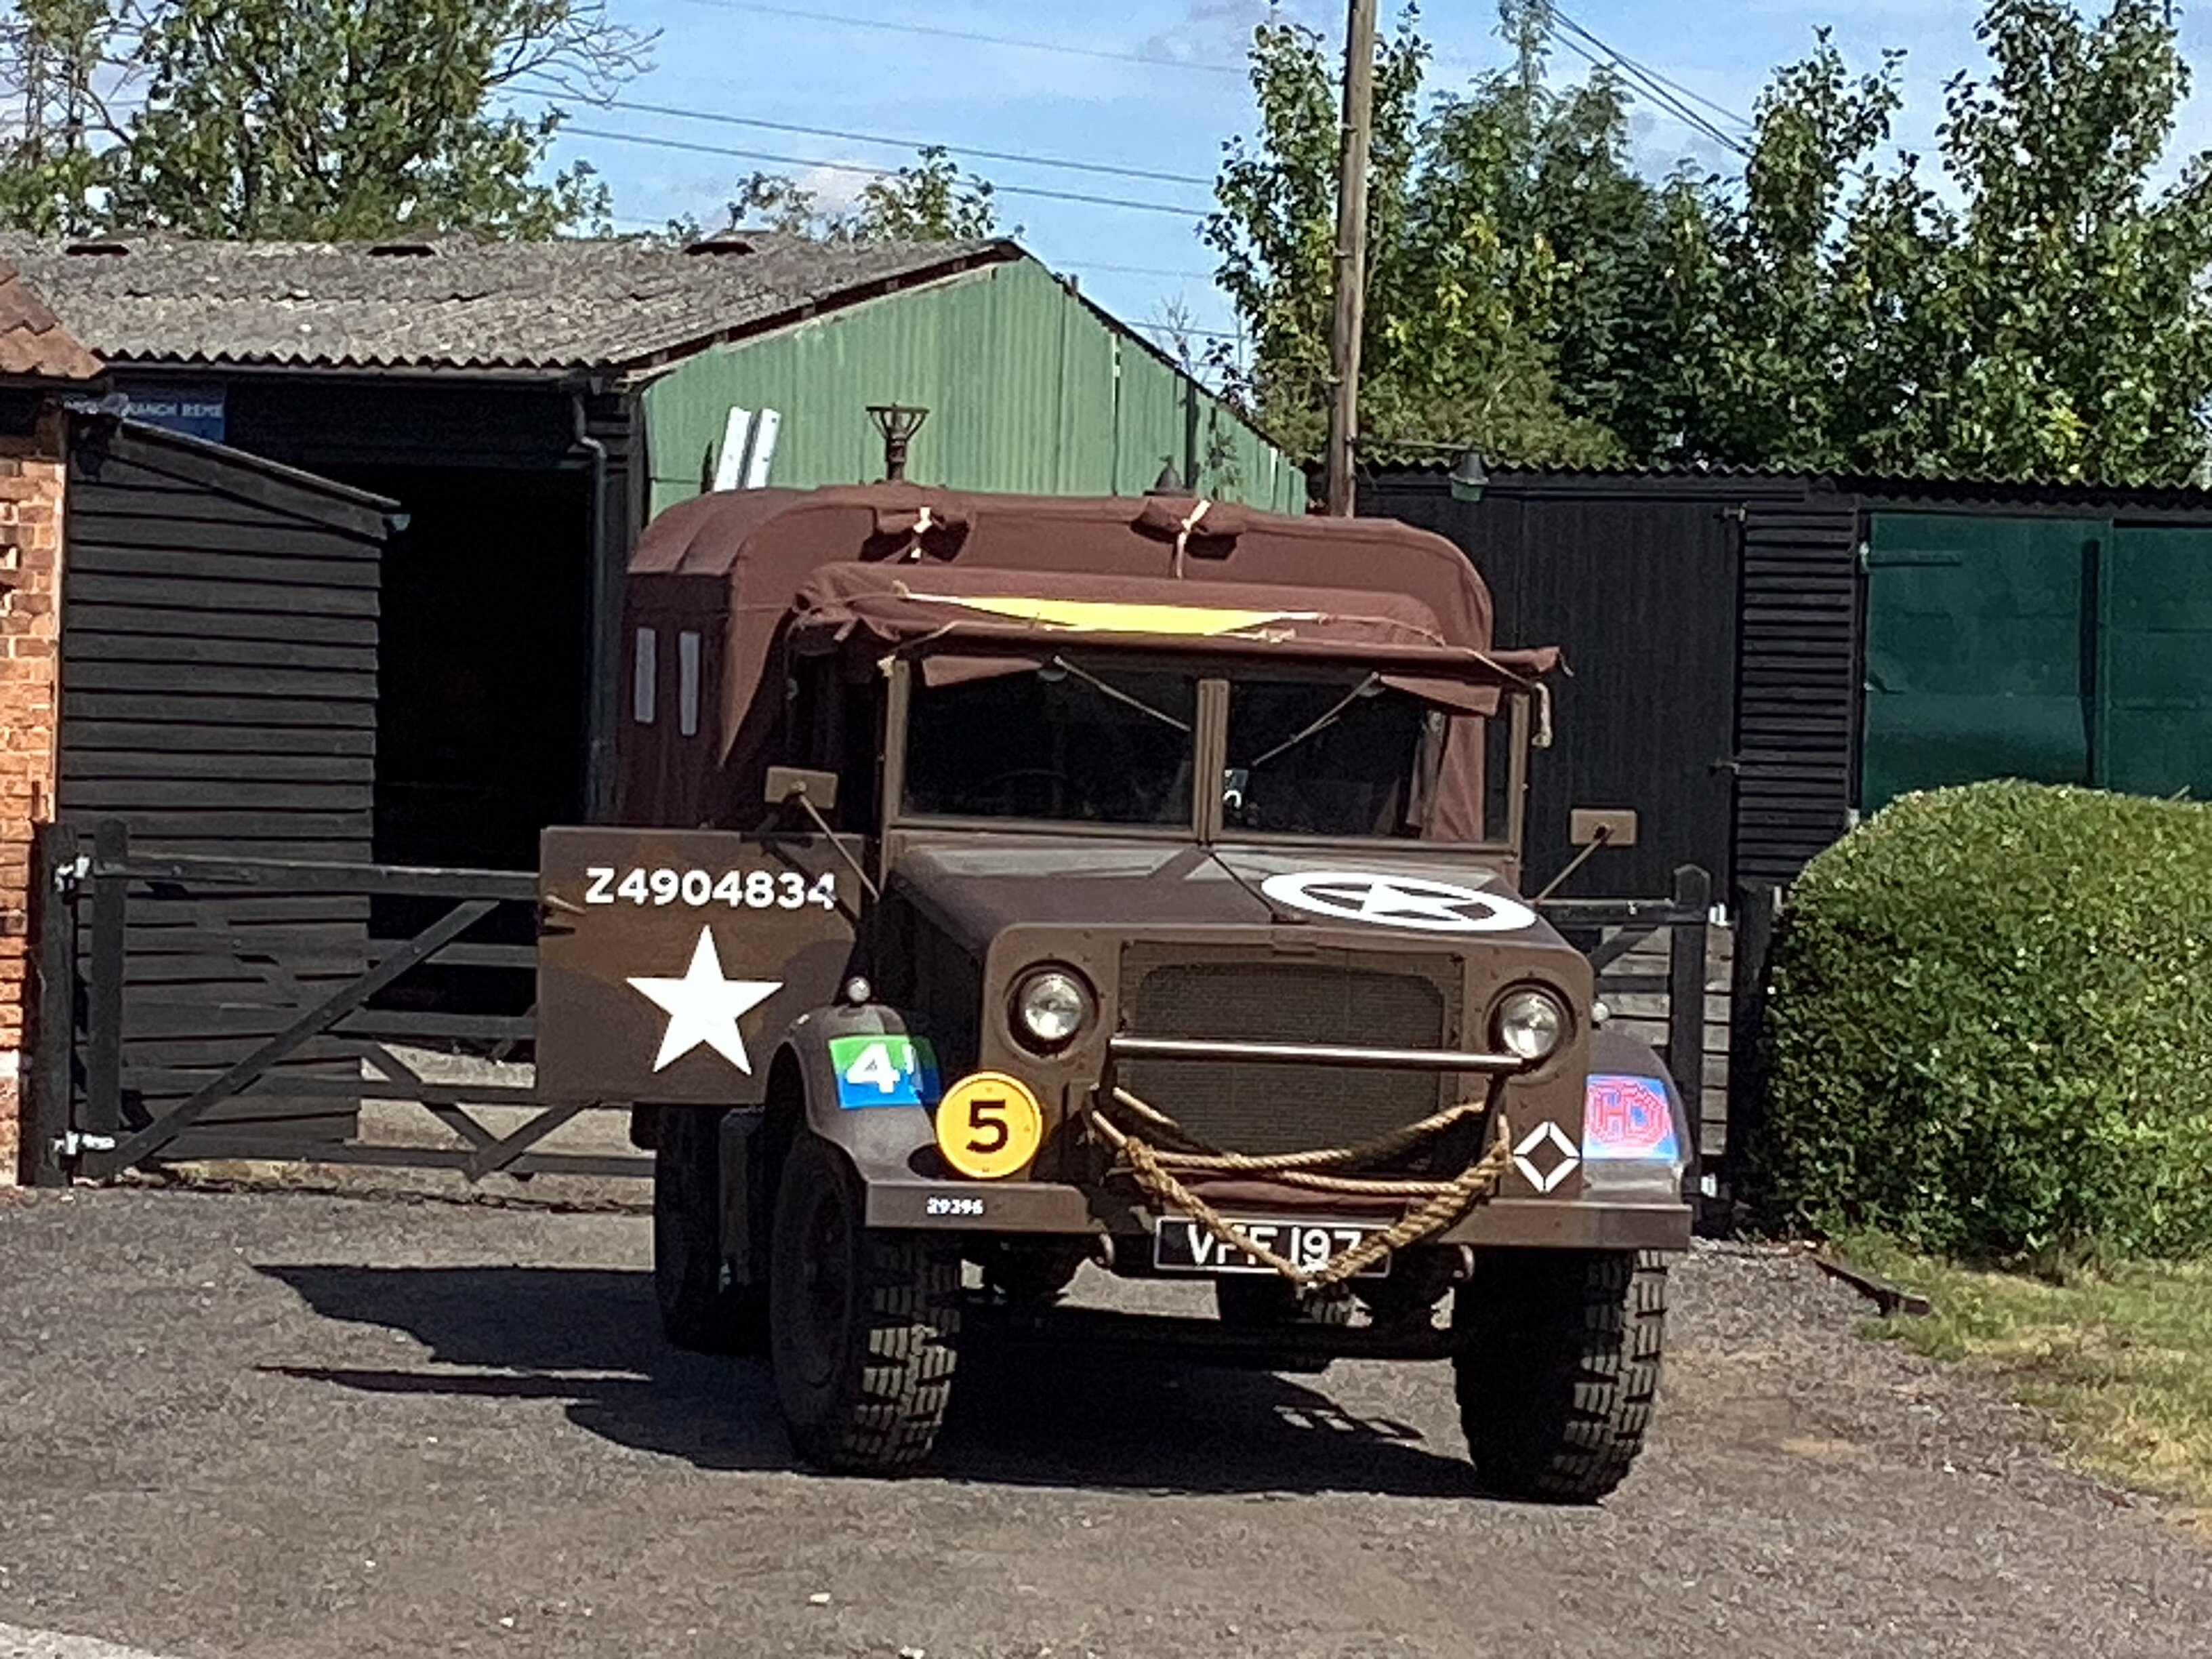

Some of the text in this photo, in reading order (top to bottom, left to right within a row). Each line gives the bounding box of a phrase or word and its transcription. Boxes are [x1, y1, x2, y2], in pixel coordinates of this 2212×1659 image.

[586, 867, 836, 909] Z4904834
[966, 1099, 1009, 1154] 5
[1290, 1225, 1362, 1271] 197
